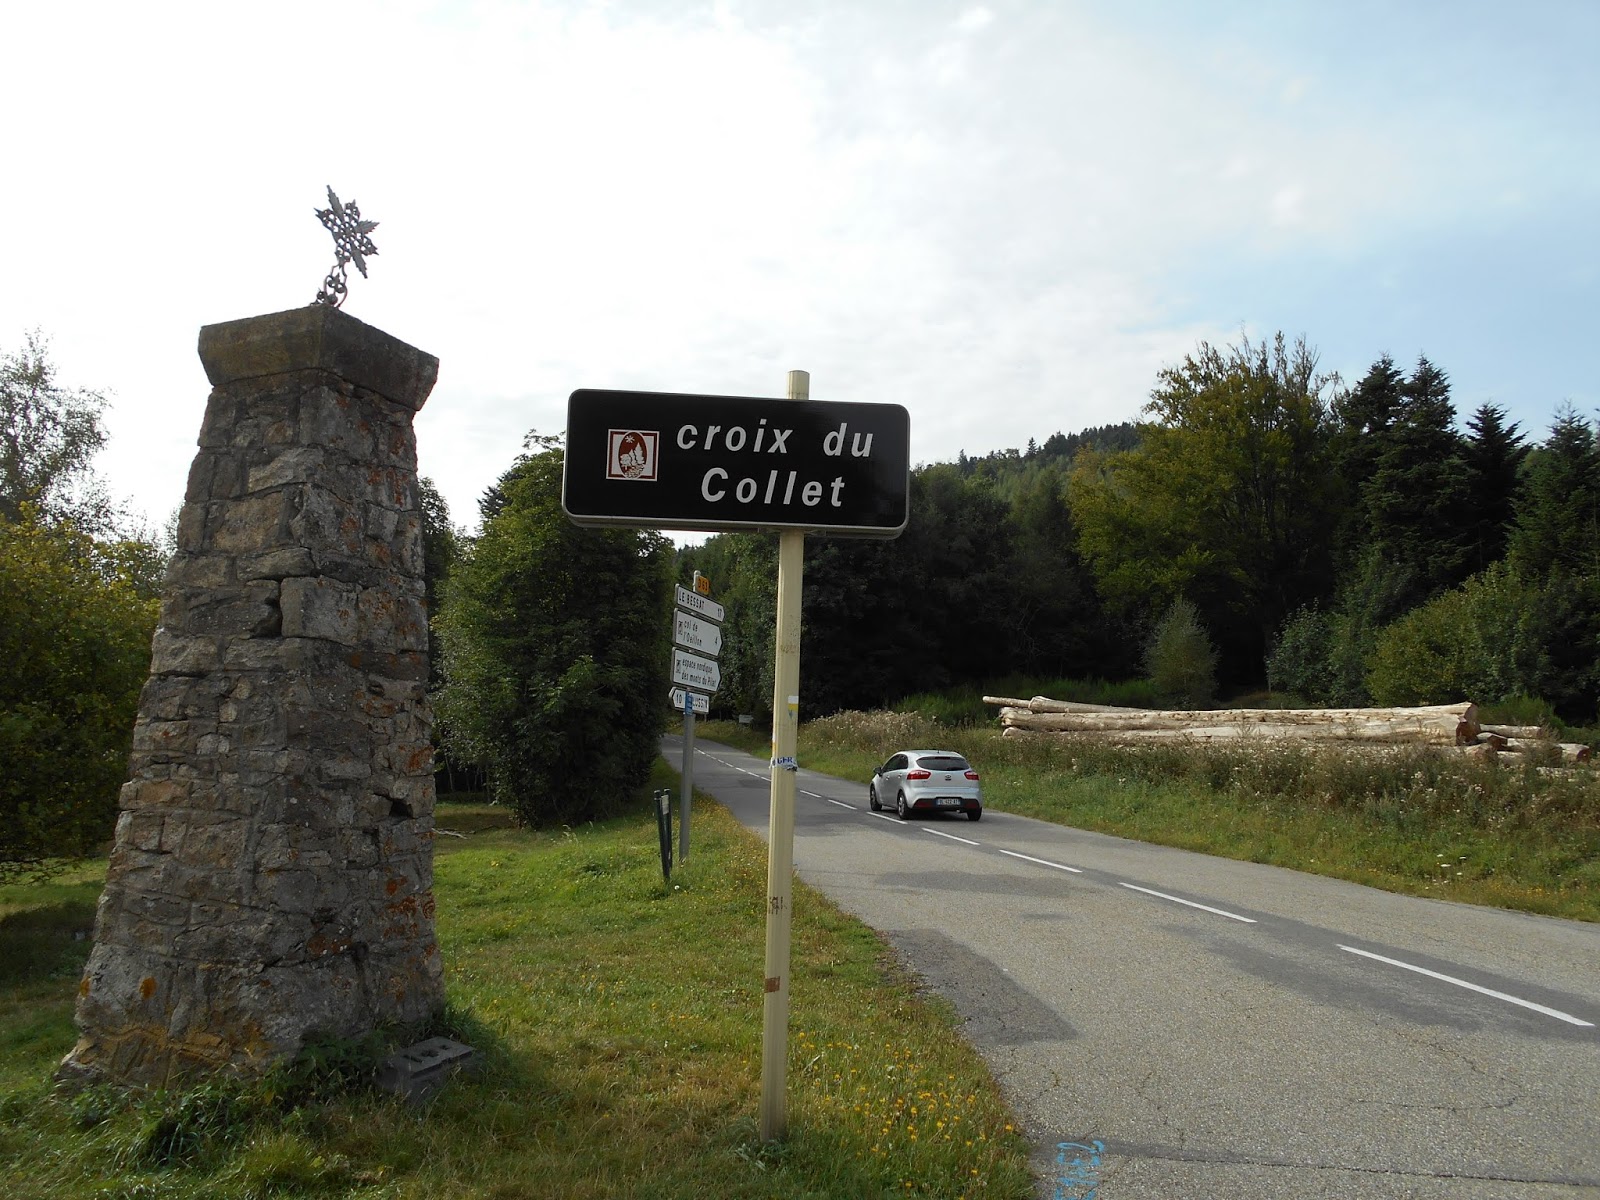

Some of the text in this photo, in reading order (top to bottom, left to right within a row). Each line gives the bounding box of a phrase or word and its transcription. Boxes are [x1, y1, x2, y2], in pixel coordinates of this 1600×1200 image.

[676, 418, 873, 458] croix du
[701, 466, 846, 507] Collet
[679, 590, 685, 602] LE
[687, 594, 705, 610] BESSAT
[693, 622, 698, 632] de
[682, 658, 713, 675] espace nordique
[681, 669, 716, 687] des monts du Pilat
[676, 693, 682, 704] 10
